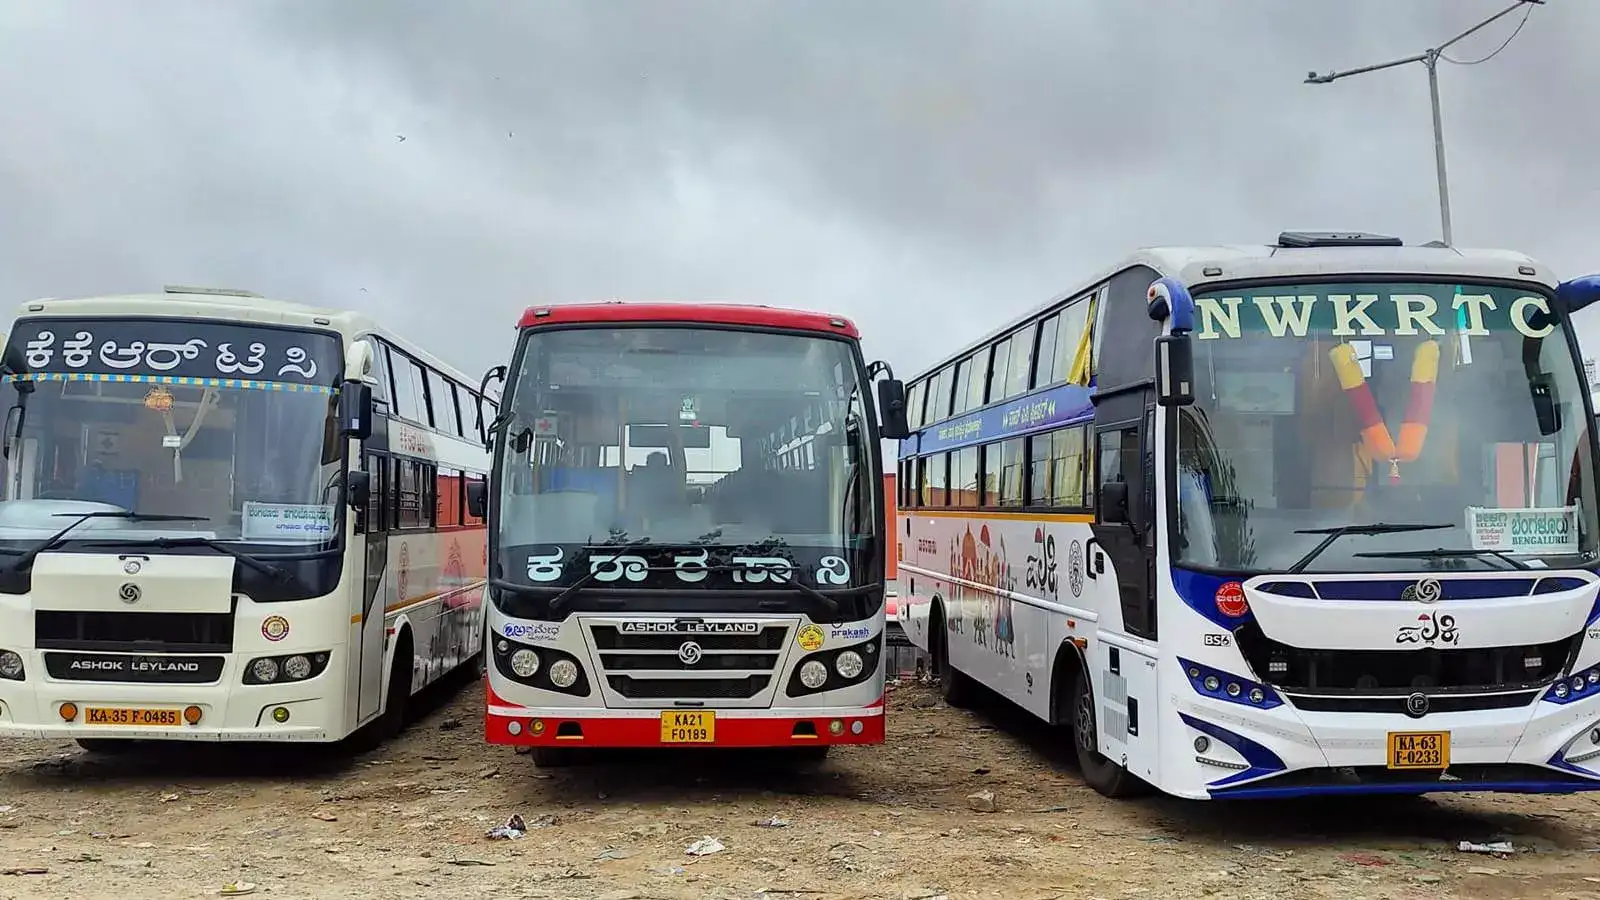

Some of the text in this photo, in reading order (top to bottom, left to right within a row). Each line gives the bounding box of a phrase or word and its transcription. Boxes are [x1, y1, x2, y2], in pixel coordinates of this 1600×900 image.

[1195, 294, 1554, 340] NWKRTC
[1512, 536, 1569, 545] BENGALURU
[624, 621, 757, 632] ASHOK LEYLAND
[832, 627, 869, 639] prakash
[1205, 635, 1229, 646] BS6
[70, 660, 199, 672] ASHOK LEYLAND
[89, 708, 176, 725] KA-35 F-0485
[674, 713, 704, 727] KA21
[670, 728, 707, 741] F0189
[1399, 736, 1437, 750] KA-63
[1396, 750, 1440, 765] F-0233
